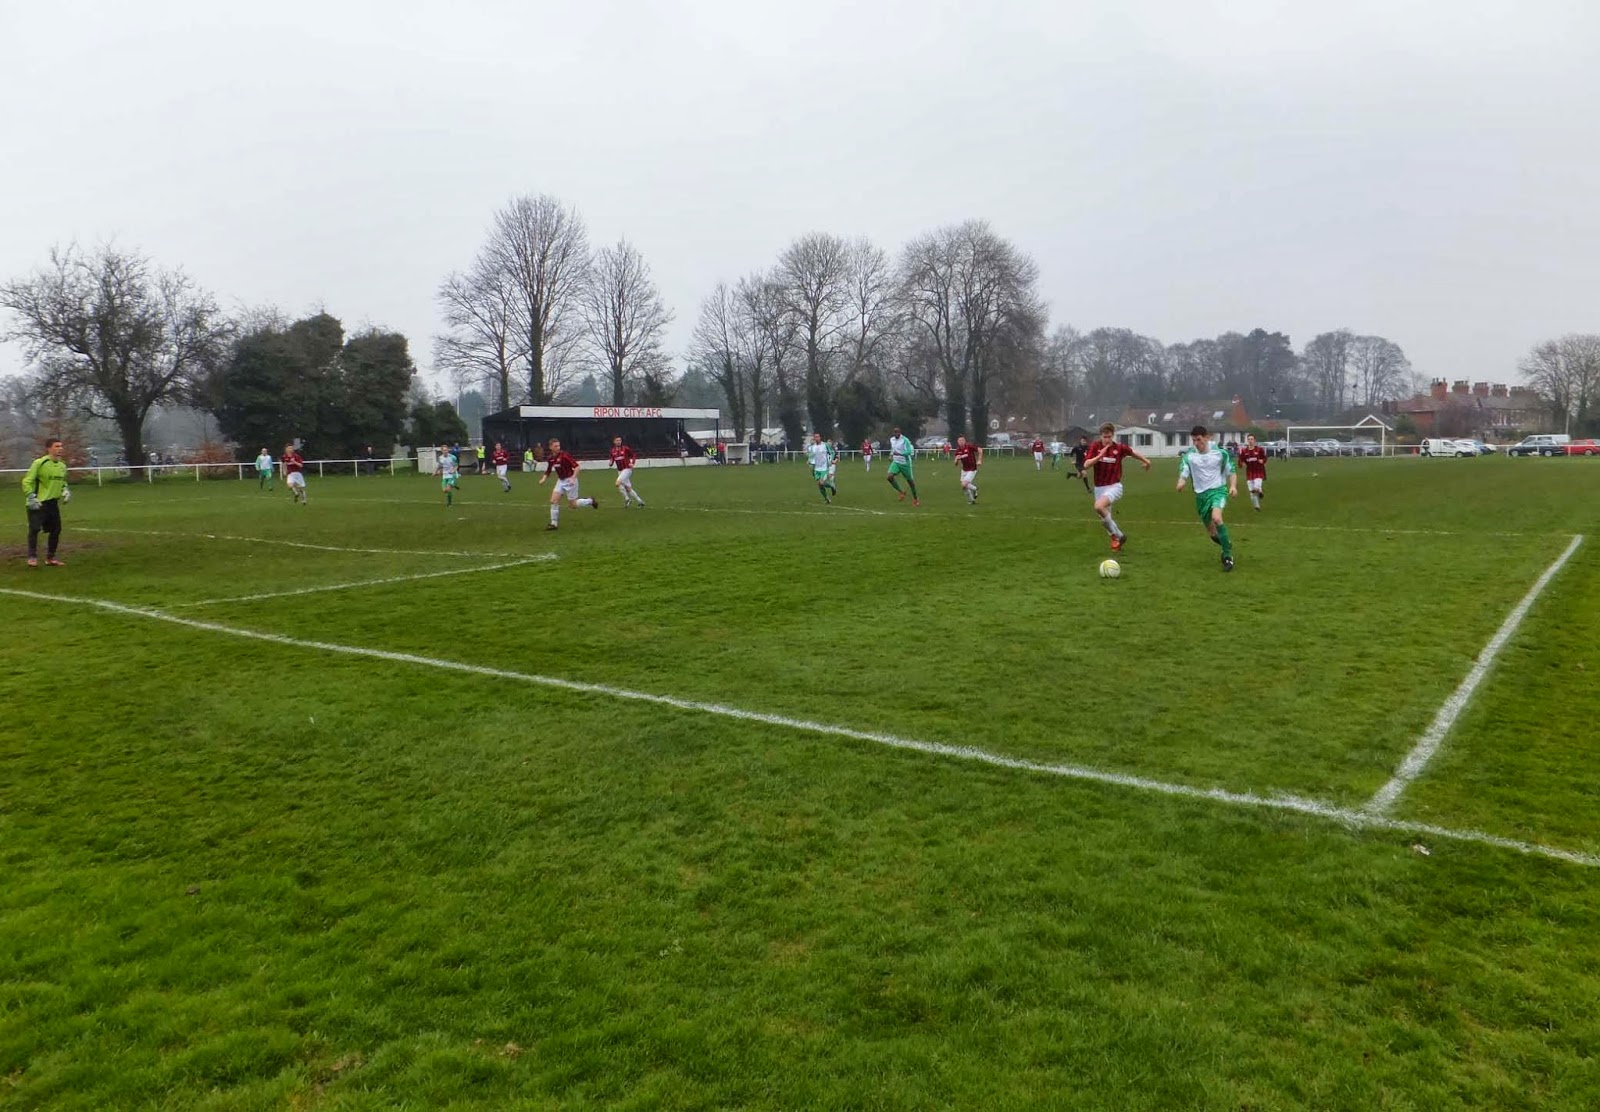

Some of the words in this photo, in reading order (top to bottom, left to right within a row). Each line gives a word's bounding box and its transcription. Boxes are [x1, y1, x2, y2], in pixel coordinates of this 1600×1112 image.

[593, 407, 620, 417] RIPON
[623, 408, 641, 417] CITY
[645, 408, 662, 418] AFC
